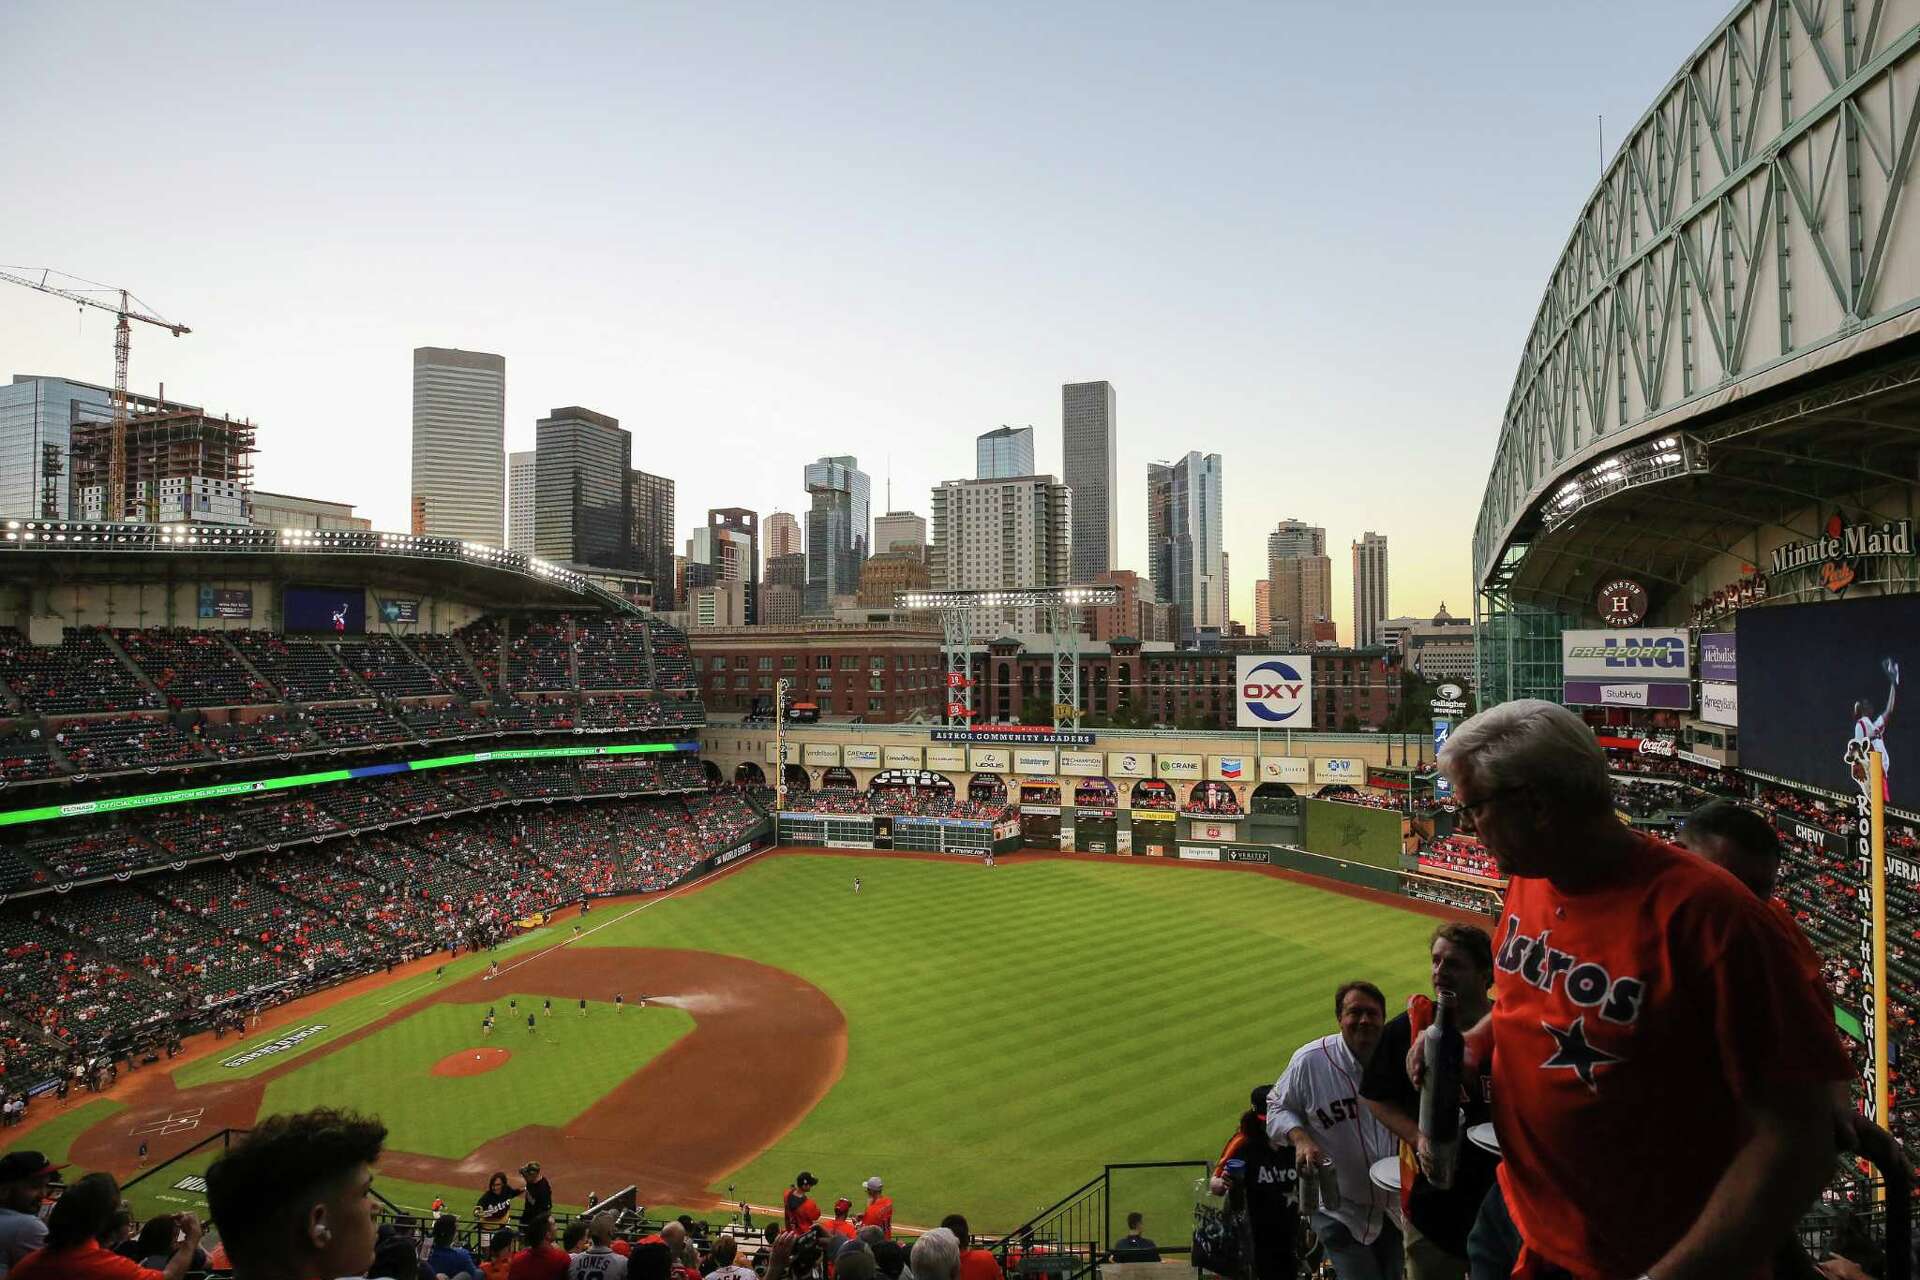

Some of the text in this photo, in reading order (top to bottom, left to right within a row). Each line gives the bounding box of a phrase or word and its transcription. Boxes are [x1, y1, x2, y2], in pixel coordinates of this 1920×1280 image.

[1771, 522, 1910, 575] Minute Maid
[1603, 581, 1640, 596] HOUSTON
[1612, 597, 1628, 612] H
[1604, 613, 1639, 625] ASTROS
[1570, 646, 1668, 658] FREEPORT
[1605, 637, 1685, 668] LNG
[1243, 684, 1303, 699] OXY
[1607, 689, 1642, 699] StubHub
[1431, 699, 1467, 709] Gallagher
[977, 733, 1041, 742] COMMUNITY
[1043, 735, 1090, 743] LEADERS
[100, 801, 131, 809] OFFICIAL
[133, 797, 163, 805] ALLERGY
[1795, 824, 1825, 847] CHEVY
[1856, 794, 1872, 876] ROOT
[722, 842, 751, 863] WORLD SERIES
[1884, 856, 1920, 882] VERA
[1858, 887, 1871, 904] 4
[1859, 918, 1874, 985] THA
[1862, 994, 1877, 1123] CHIKIN
[1315, 1098, 1357, 1130] AST
[1258, 1165, 1298, 1184] Astro
[576, 1256, 610, 1271] JONES
